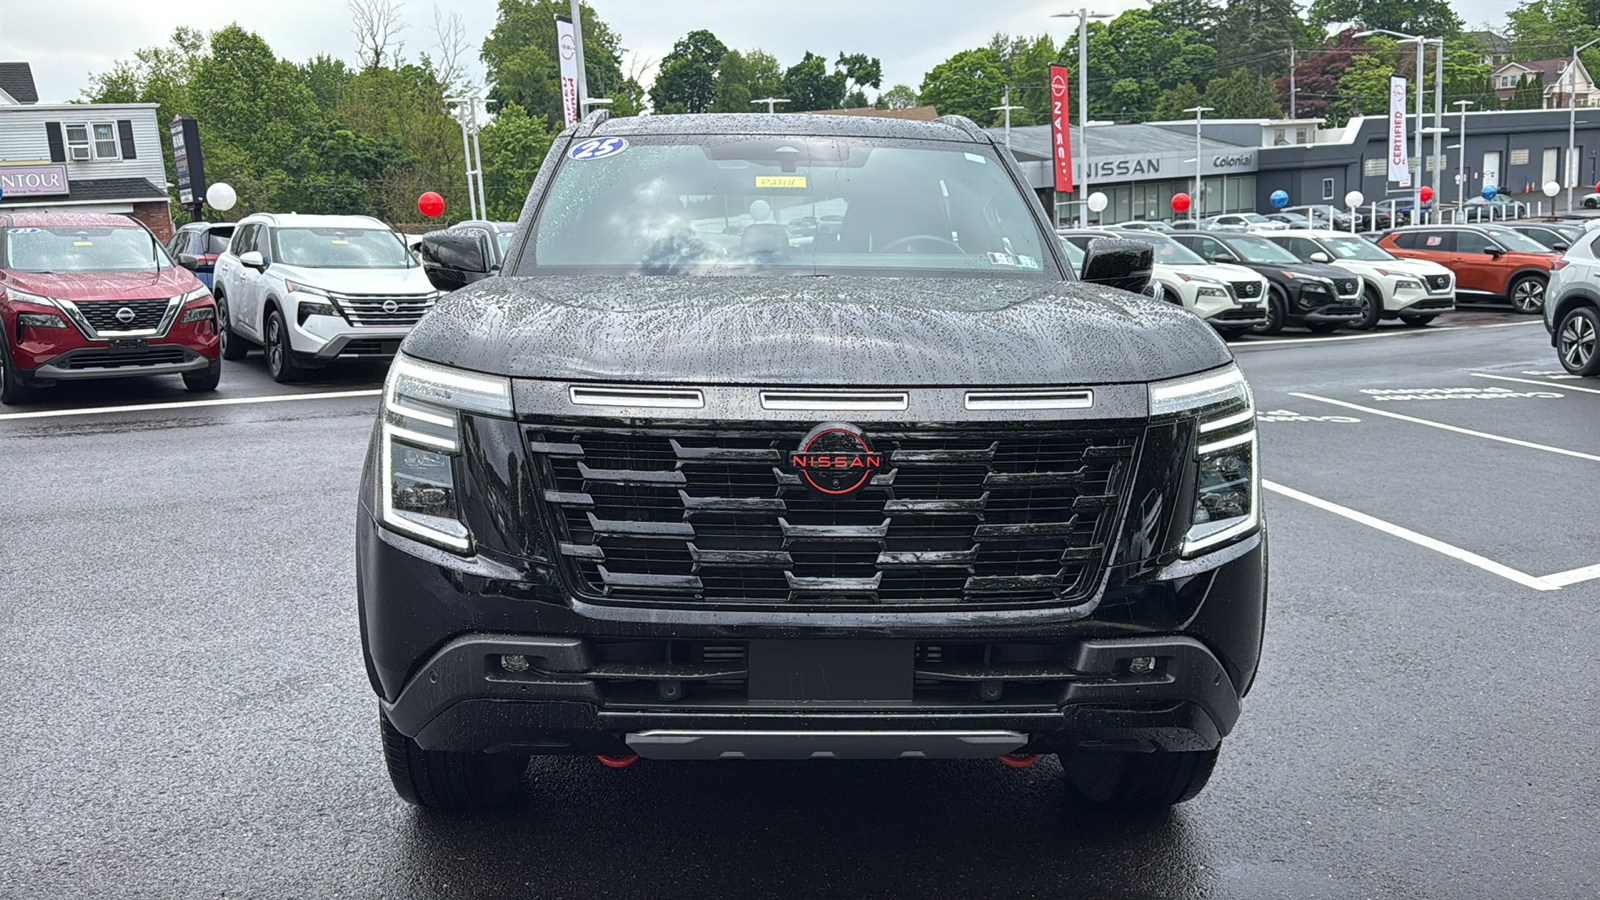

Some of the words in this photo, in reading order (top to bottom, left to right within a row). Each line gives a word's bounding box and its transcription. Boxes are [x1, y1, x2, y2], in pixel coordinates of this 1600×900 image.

[575, 138, 619, 159] 25
[1393, 110, 1403, 166] CERTIFIED
[1077, 158, 1160, 179] NISSAN
[1213, 154, 1252, 168] Colonial
[792, 455, 880, 468] NISSAN
